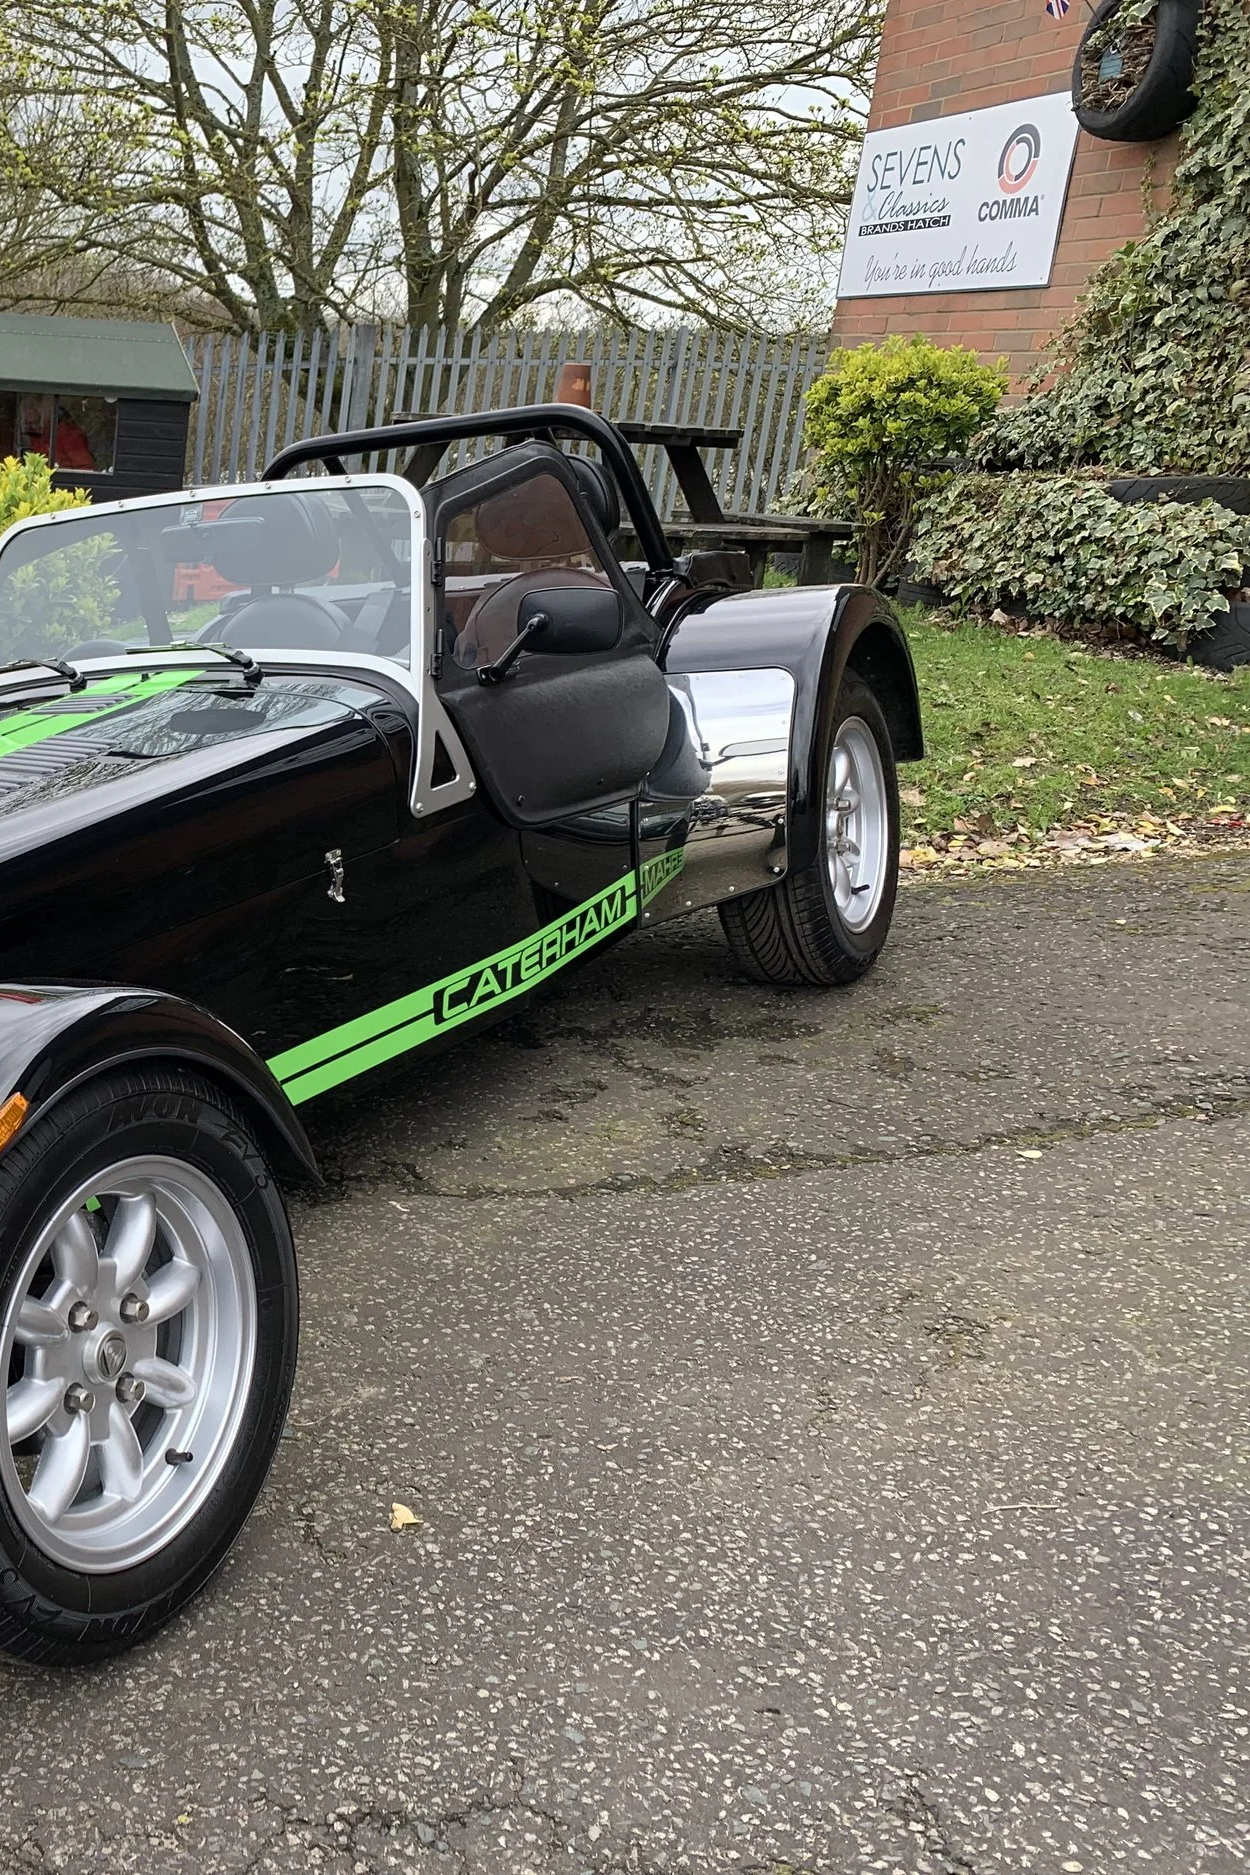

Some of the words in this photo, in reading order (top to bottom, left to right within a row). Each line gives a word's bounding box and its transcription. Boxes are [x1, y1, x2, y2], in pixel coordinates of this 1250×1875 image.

[866, 138, 966, 193] SEVENS
[860, 220, 905, 236] BRANDS
[908, 216, 950, 231] HATCH
[862, 191, 877, 222] &
[878, 190, 950, 221] Classics
[978, 198, 1040, 222] COMMA
[864, 254, 908, 291] You're
[913, 259, 926, 279] in
[928, 245, 967, 288] good
[966, 241, 1018, 275] hands
[442, 889, 622, 1019] CATERHAM
